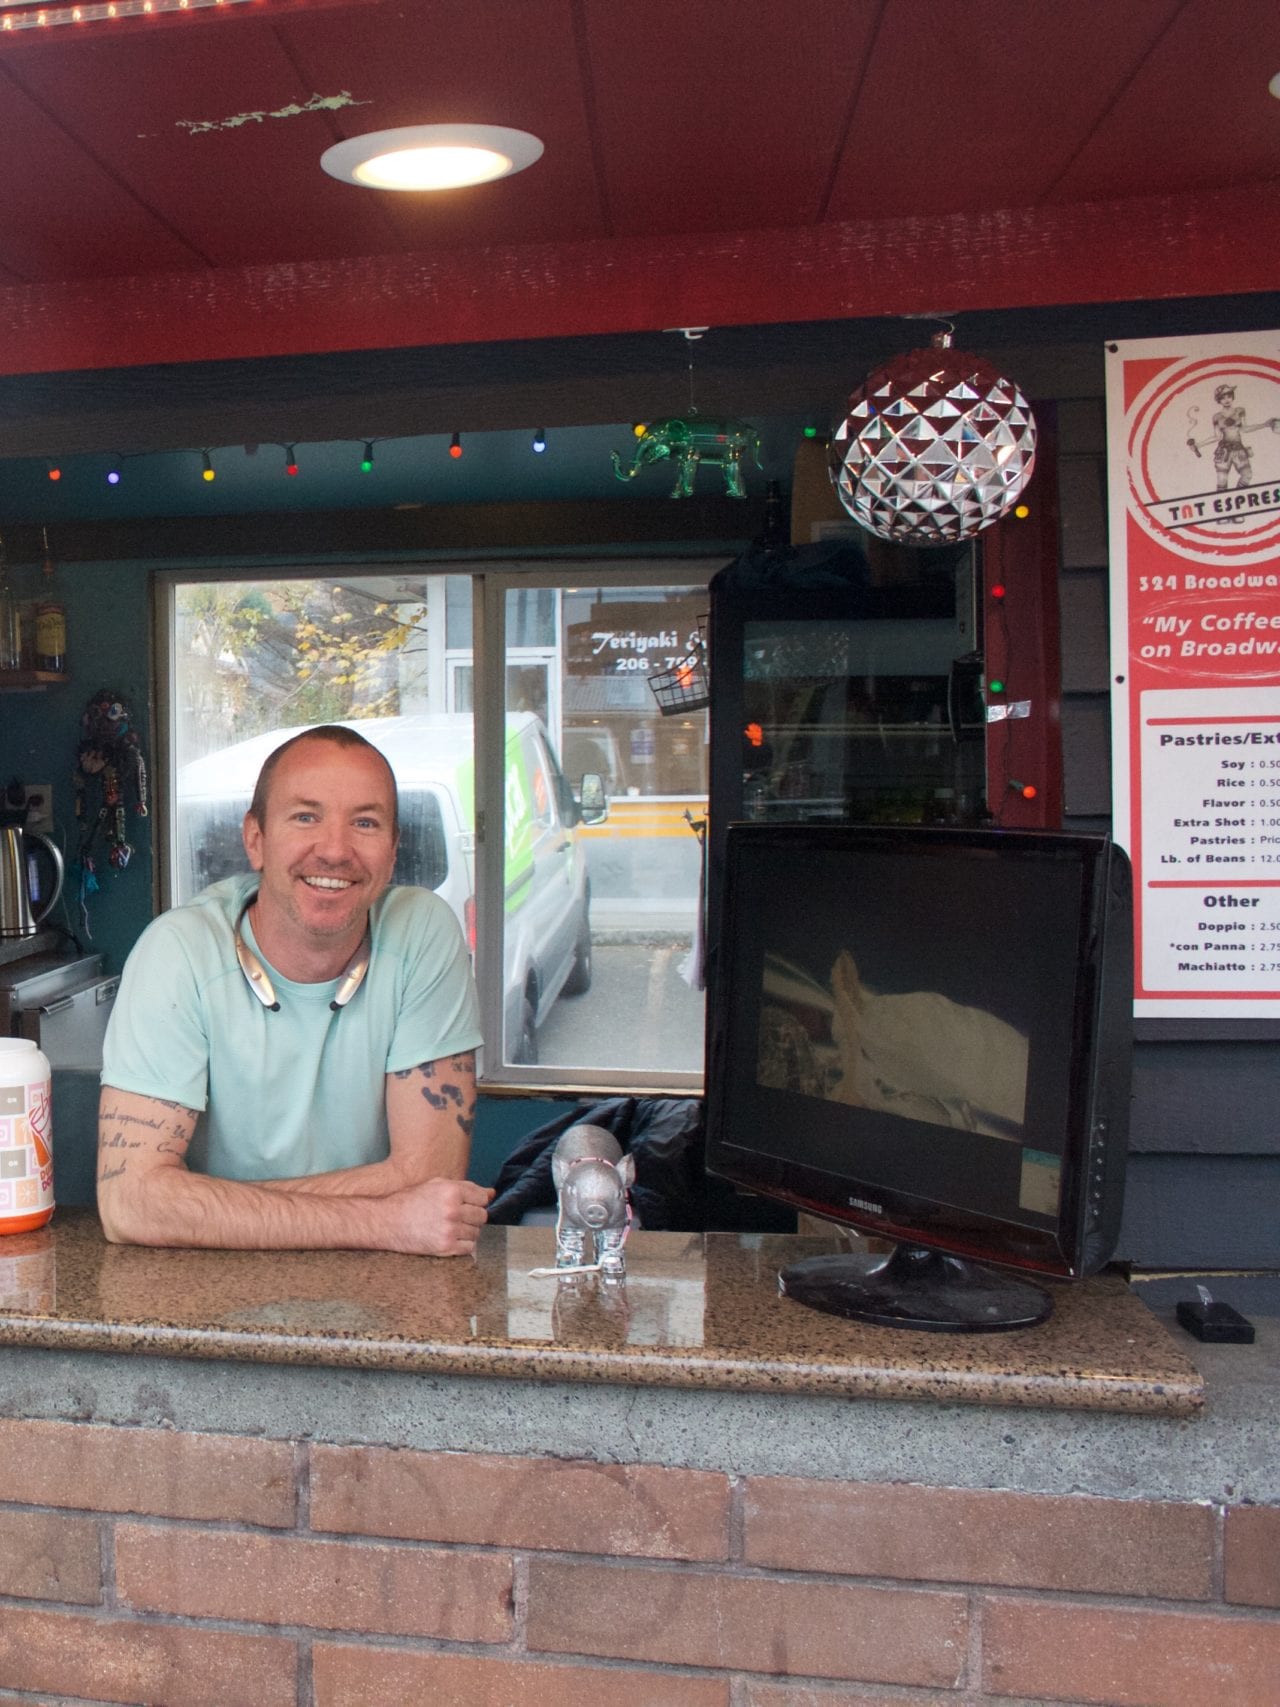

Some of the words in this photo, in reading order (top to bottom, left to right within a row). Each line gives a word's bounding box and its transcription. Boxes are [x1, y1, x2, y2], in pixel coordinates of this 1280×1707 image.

[591, 630, 677, 654] Teriyaki
[1140, 644, 1171, 658] on
[1180, 637, 1280, 657] Broadw
[616, 657, 649, 671] 206
[1221, 760, 1245, 770] Soy
[1217, 778, 1245, 787] Rice
[1203, 799, 1245, 807] Flavor
[1174, 819, 1210, 827] Extra
[1215, 818, 1245, 826] Shot
[1190, 836, 1245, 845] Pastries
[1161, 855, 1181, 863] Lb.
[1187, 854, 1200, 863] of
[1206, 854, 1245, 863] Beans
[1203, 895, 1260, 907] Other
[1198, 922, 1246, 932] Doppio
[1204, 943, 1246, 951] Panna
[1178, 963, 1246, 971] Machiatto
